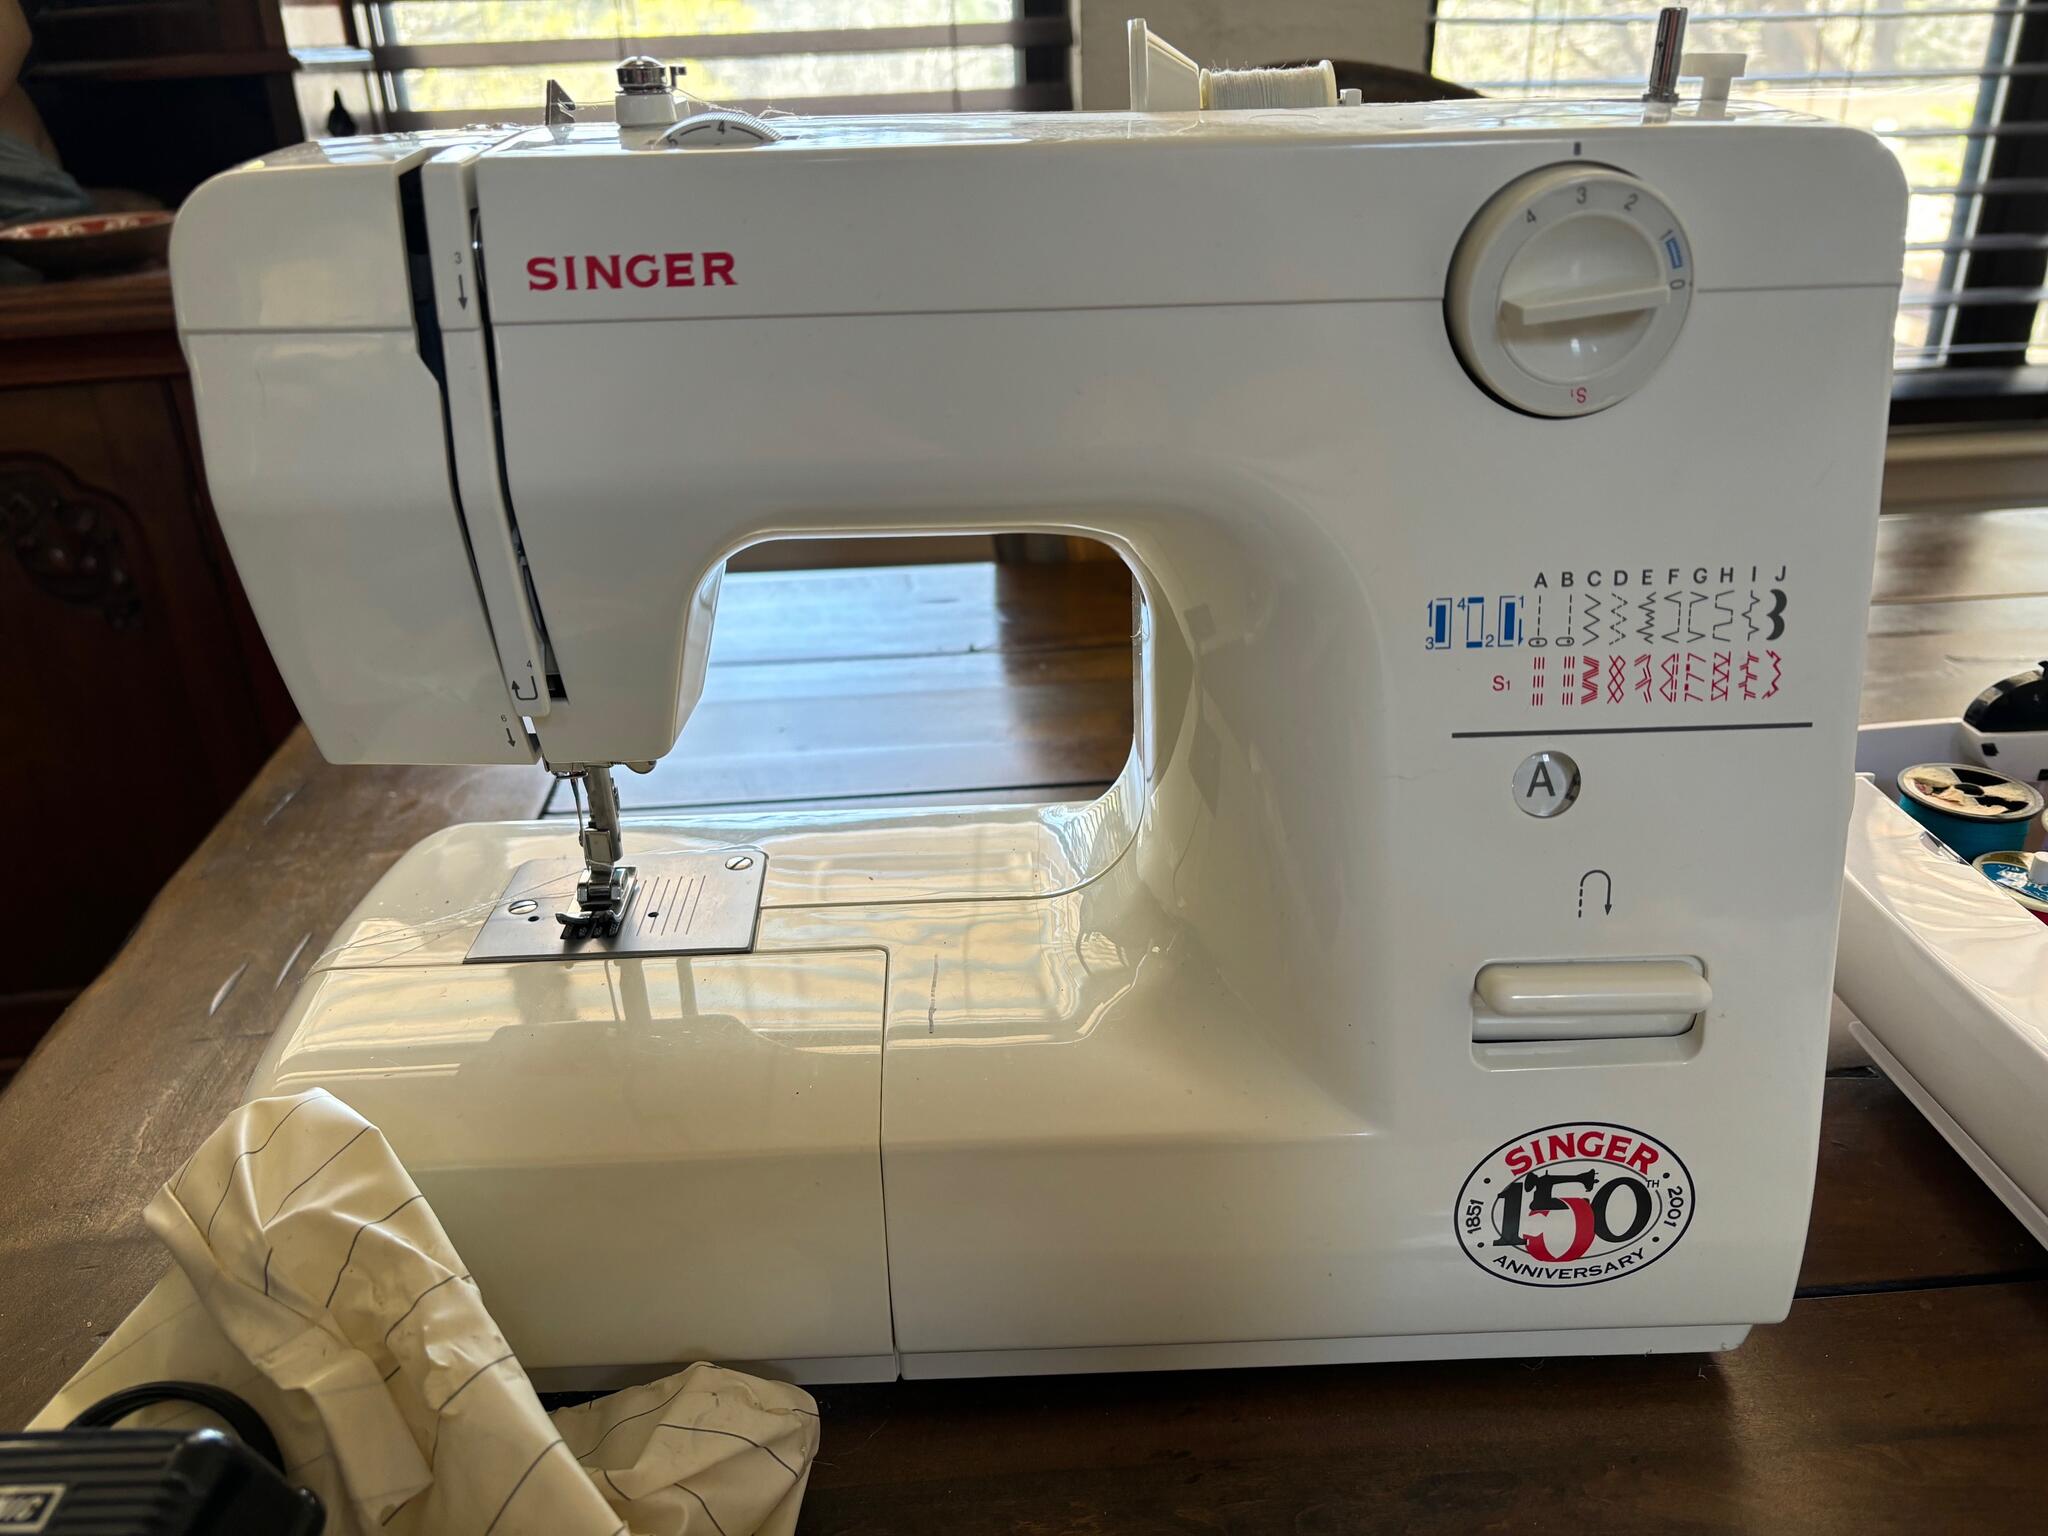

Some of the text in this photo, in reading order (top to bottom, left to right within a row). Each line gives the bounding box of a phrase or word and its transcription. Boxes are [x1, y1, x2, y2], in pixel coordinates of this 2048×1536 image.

[717, 120, 725, 135] 4
[1577, 187, 1587, 204] 3
[1624, 194, 1638, 211] 2
[1526, 209, 1536, 223] 4
[454, 252, 462, 264] 3
[527, 251, 738, 291] SINGER
[1534, 565, 1786, 588] A B C D E F G H I J
[1457, 597, 1466, 611] 4
[1425, 636, 1434, 650] 3
[1485, 634, 1494, 648] 2
[526, 659, 533, 668] 4
[1493, 675, 1511, 691] S1
[1526, 761, 1556, 798] A
[1504, 1131, 1659, 1176] SINGER
[1492, 1169, 1652, 1262] 150
[1663, 1186, 1684, 1228] 2001
[1465, 1199, 1484, 1234] 1851
[1492, 1248, 1645, 1280] ANNIVERSARY
